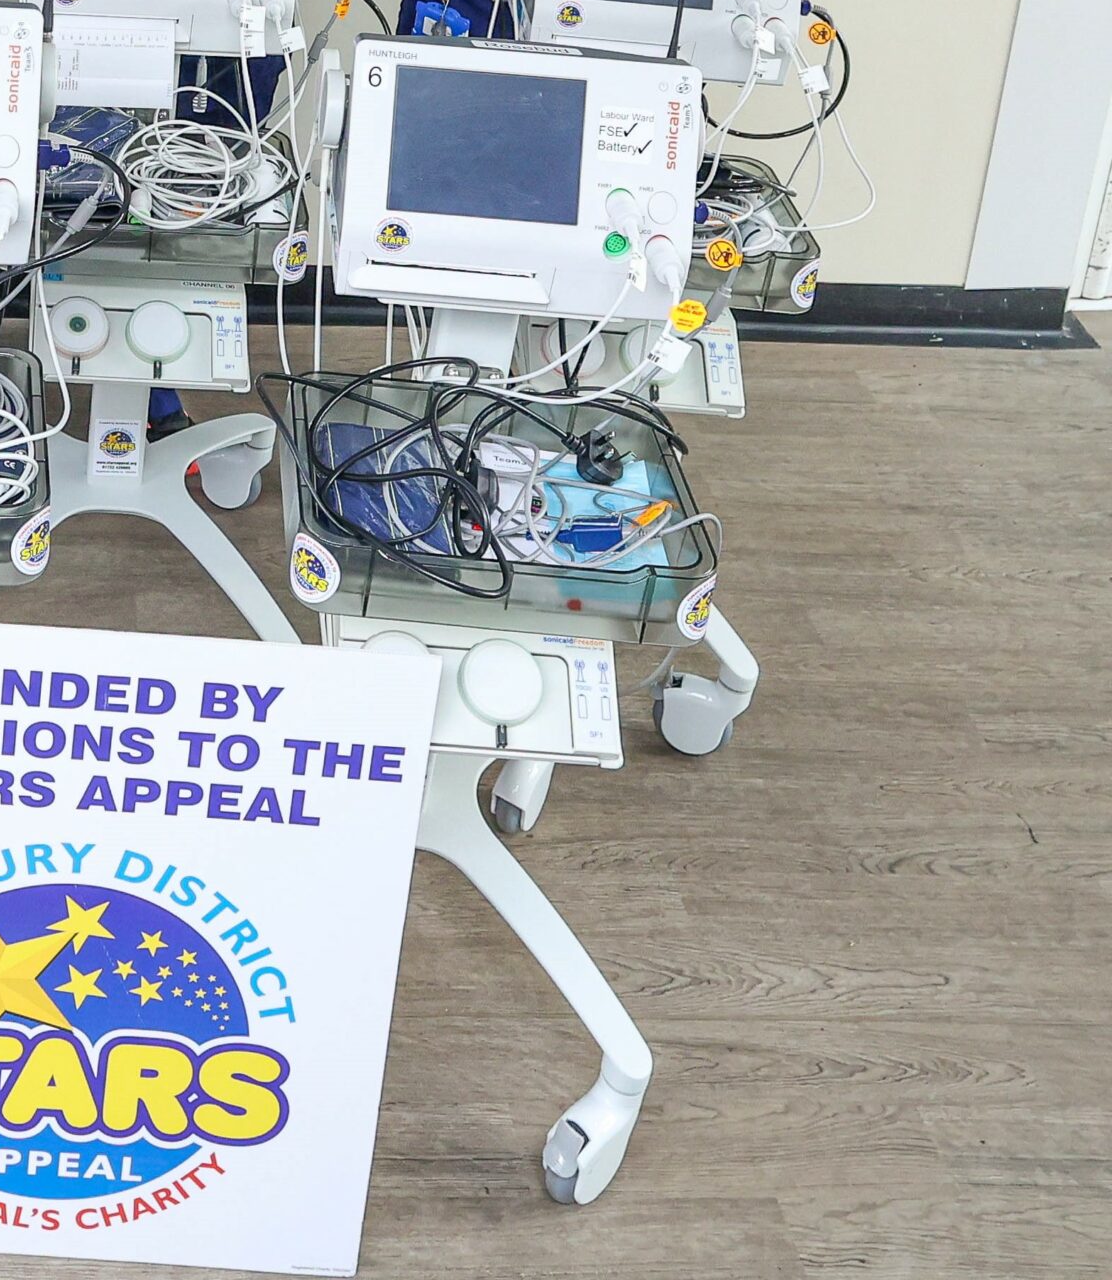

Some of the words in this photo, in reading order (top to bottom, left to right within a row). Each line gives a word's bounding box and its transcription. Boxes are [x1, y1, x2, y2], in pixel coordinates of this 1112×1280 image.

[556, 13, 583, 23] STARS
[367, 49, 418, 60] HUNTLEIGH
[8, 45, 21, 113] sonicaid
[368, 66, 382, 88] 6
[599, 110, 629, 120] Labour
[632, 114, 655, 122] Ward
[598, 125, 624, 137] FSE
[666, 101, 680, 170] sonicaid
[598, 140, 638, 155] Battery
[376, 233, 411, 246] STARS
[99, 441, 136, 451] STARS
[200, 682, 284, 723] BY
[178, 730, 261, 773] TO
[283, 738, 406, 783] THE
[77, 775, 321, 827] APPEAL
[114, 849, 297, 1024] DISTRICT
[75, 1152, 227, 1230] CHARITY
